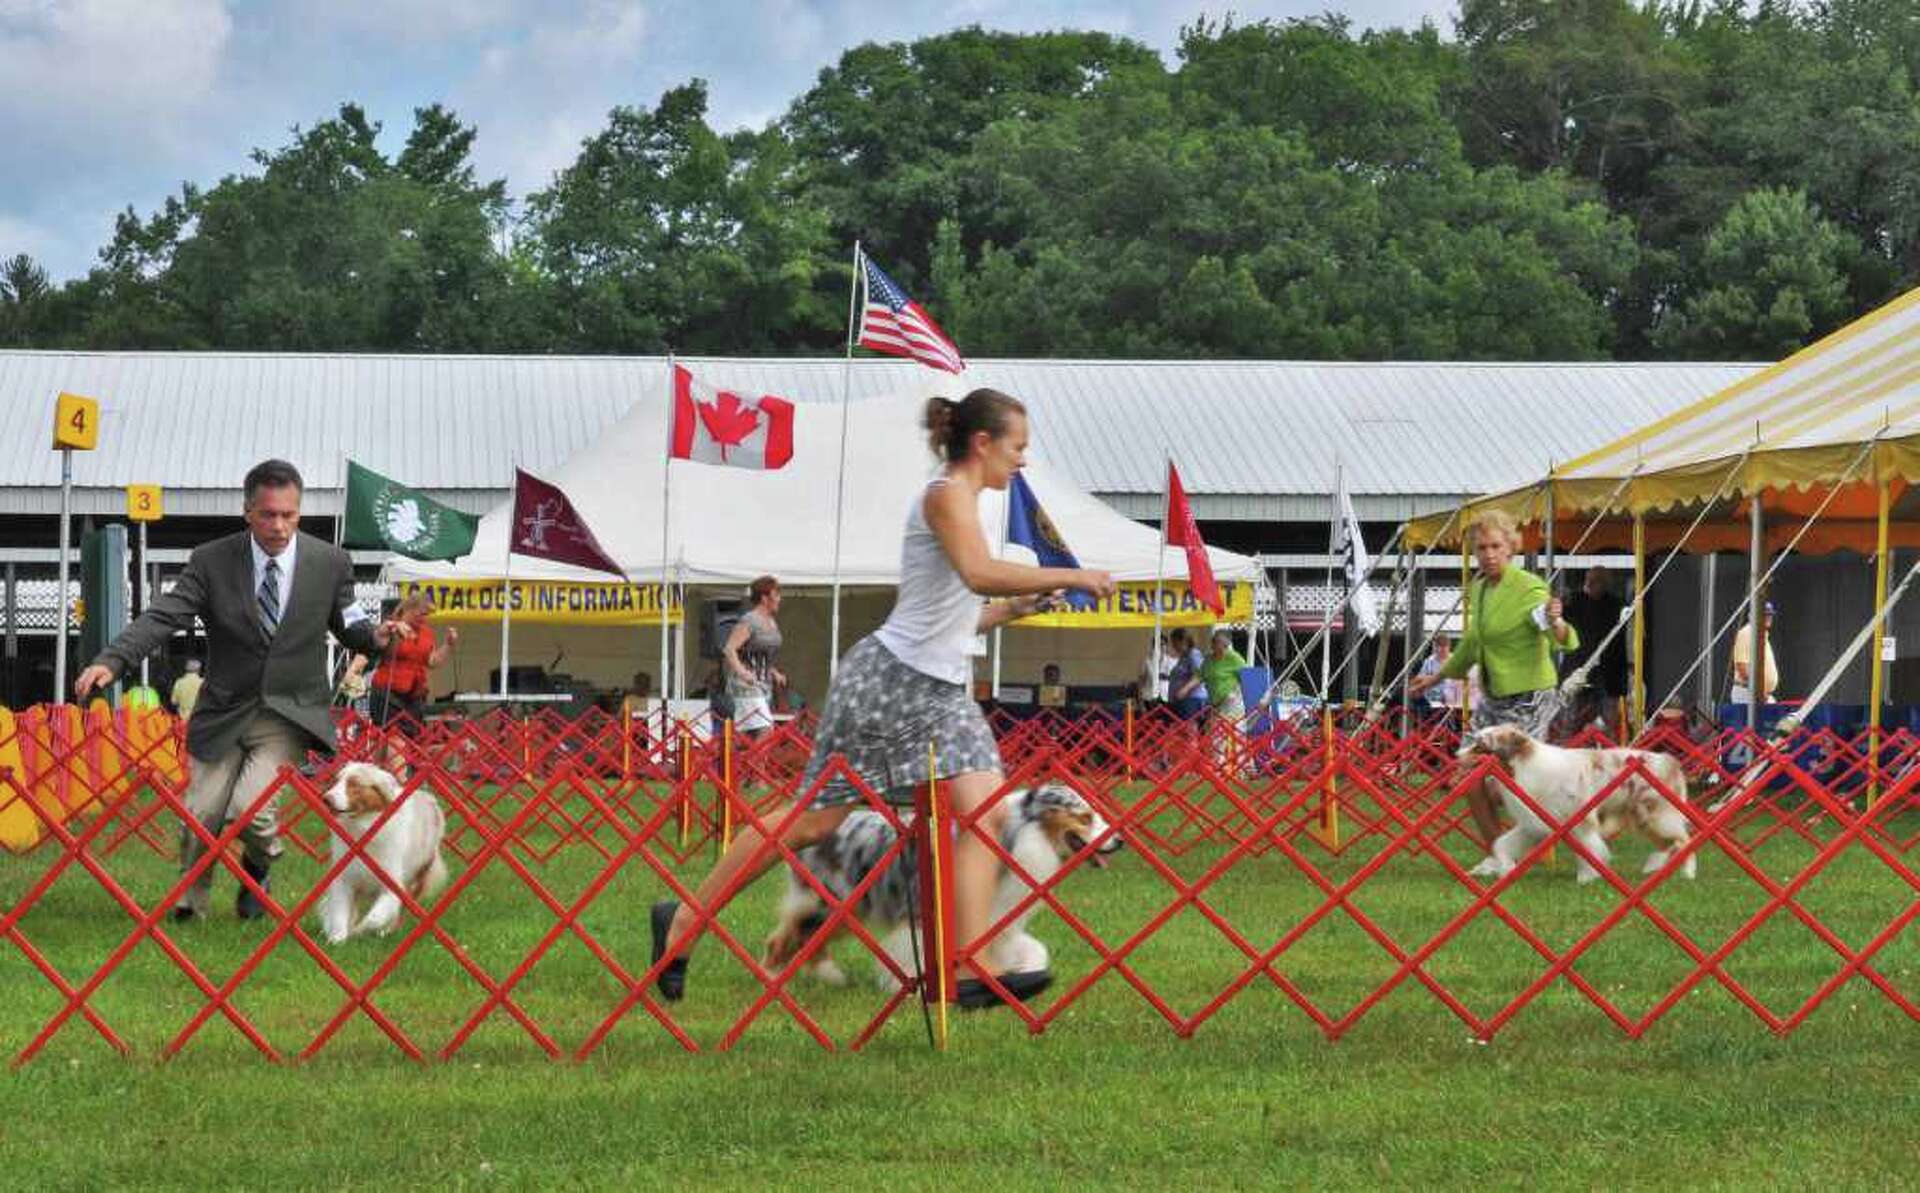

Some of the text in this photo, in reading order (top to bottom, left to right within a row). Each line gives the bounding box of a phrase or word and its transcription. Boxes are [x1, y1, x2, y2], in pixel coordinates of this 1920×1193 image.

[71, 407, 85, 434] 4
[138, 491, 151, 511] 3
[531, 584, 681, 611] INFORMATION
